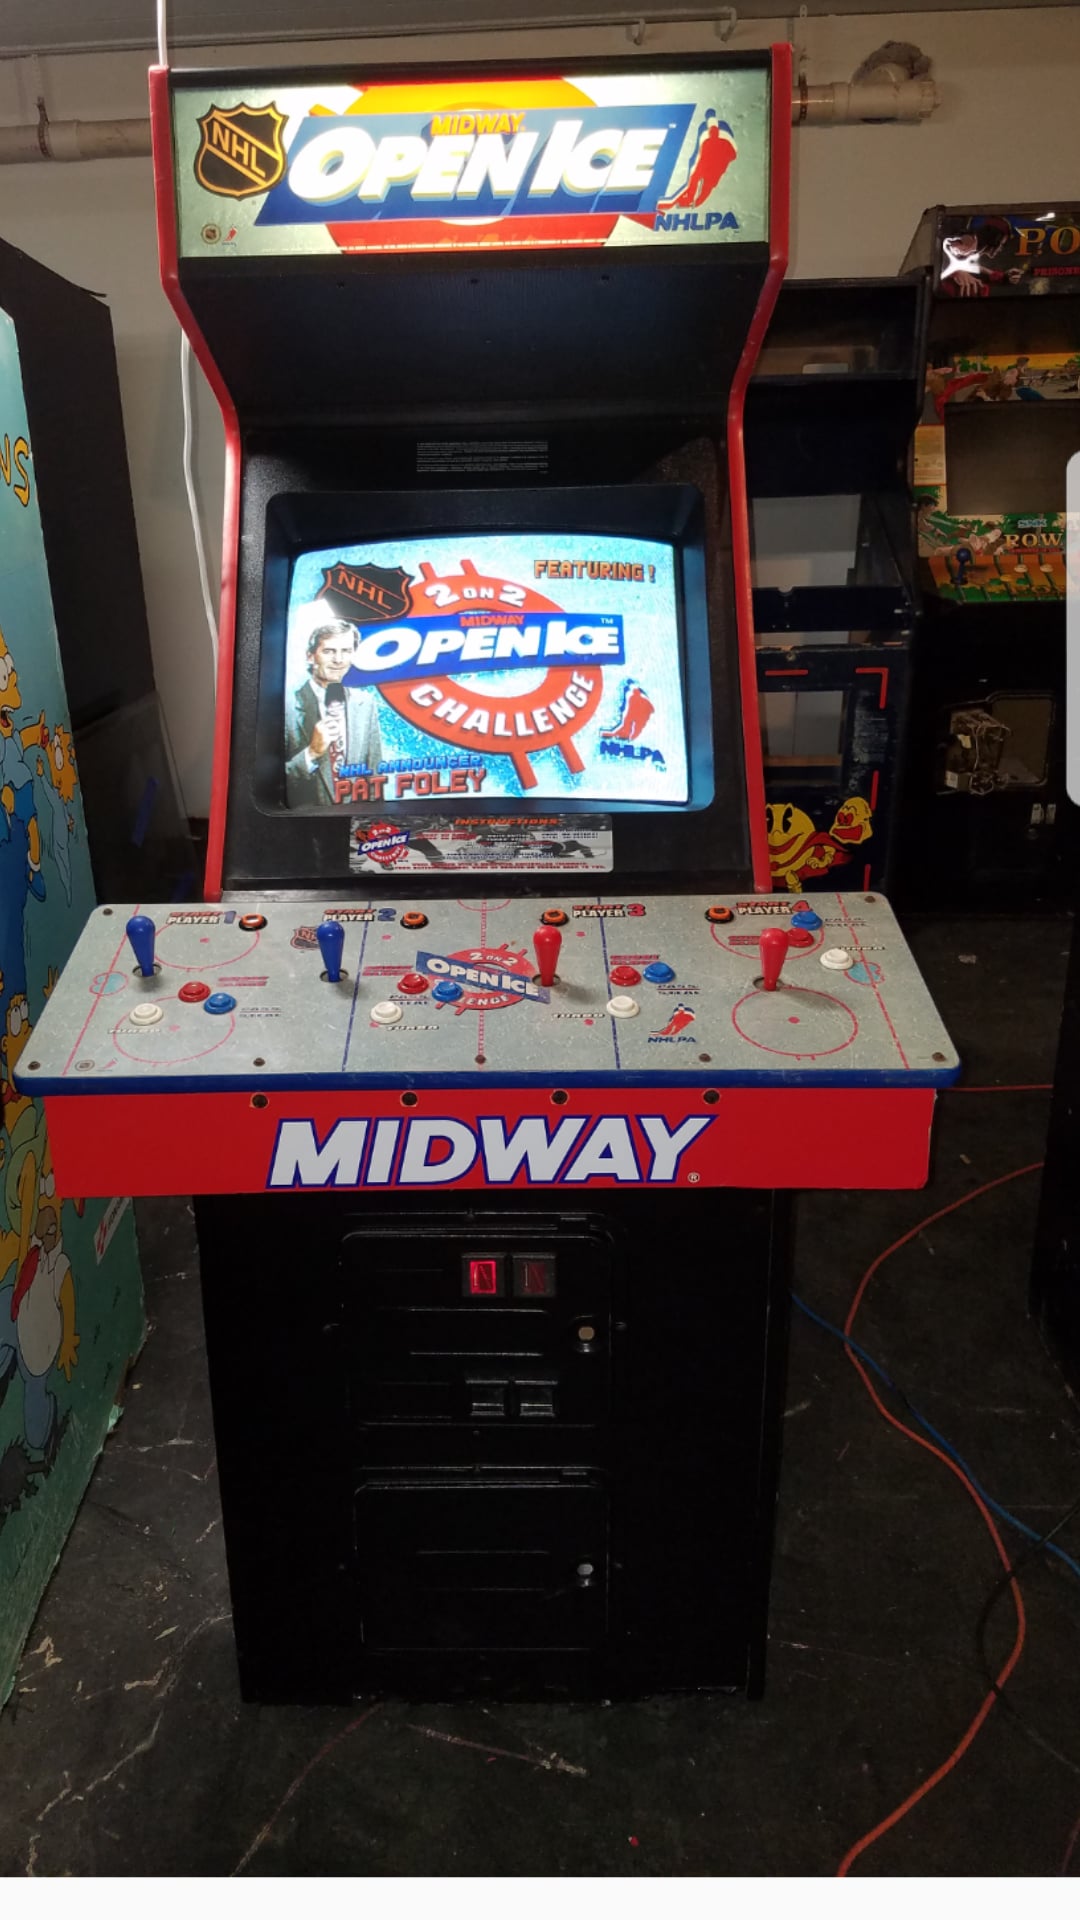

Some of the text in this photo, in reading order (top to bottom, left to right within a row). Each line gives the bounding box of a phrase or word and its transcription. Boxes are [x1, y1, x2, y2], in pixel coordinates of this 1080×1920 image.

[430, 112, 526, 136] MIDWAY
[212, 121, 266, 179] NHL
[288, 119, 668, 205] OPEN ICE
[654, 211, 740, 232] NHLPA
[533, 559, 645, 581] FEATURING
[337, 570, 393, 611] NHL
[425, 583, 527, 608] 2 ON 2
[460, 615, 526, 628] MIDWAY
[350, 625, 541, 672] OPEN
[544, 620, 620, 657] ICE
[409, 670, 595, 737] CHALLENGE
[600, 740, 666, 764] NHLPA
[338, 754, 483, 778] NHL ANNOUNCER
[333, 768, 487, 805] PAT FOLEY
[361, 838, 391, 852] OPEN
[391, 834, 409, 846] ICE
[166, 910, 237, 925] PLAYER 1
[322, 907, 397, 922] PLAYER 2
[573, 903, 646, 918] PLAYER 3
[737, 906, 794, 915] PLAYER
[426, 958, 499, 987] OPEN
[501, 974, 540, 997] ICE
[647, 1035, 697, 1044] NHLPA
[266, 1114, 719, 1190] MIDWAY
